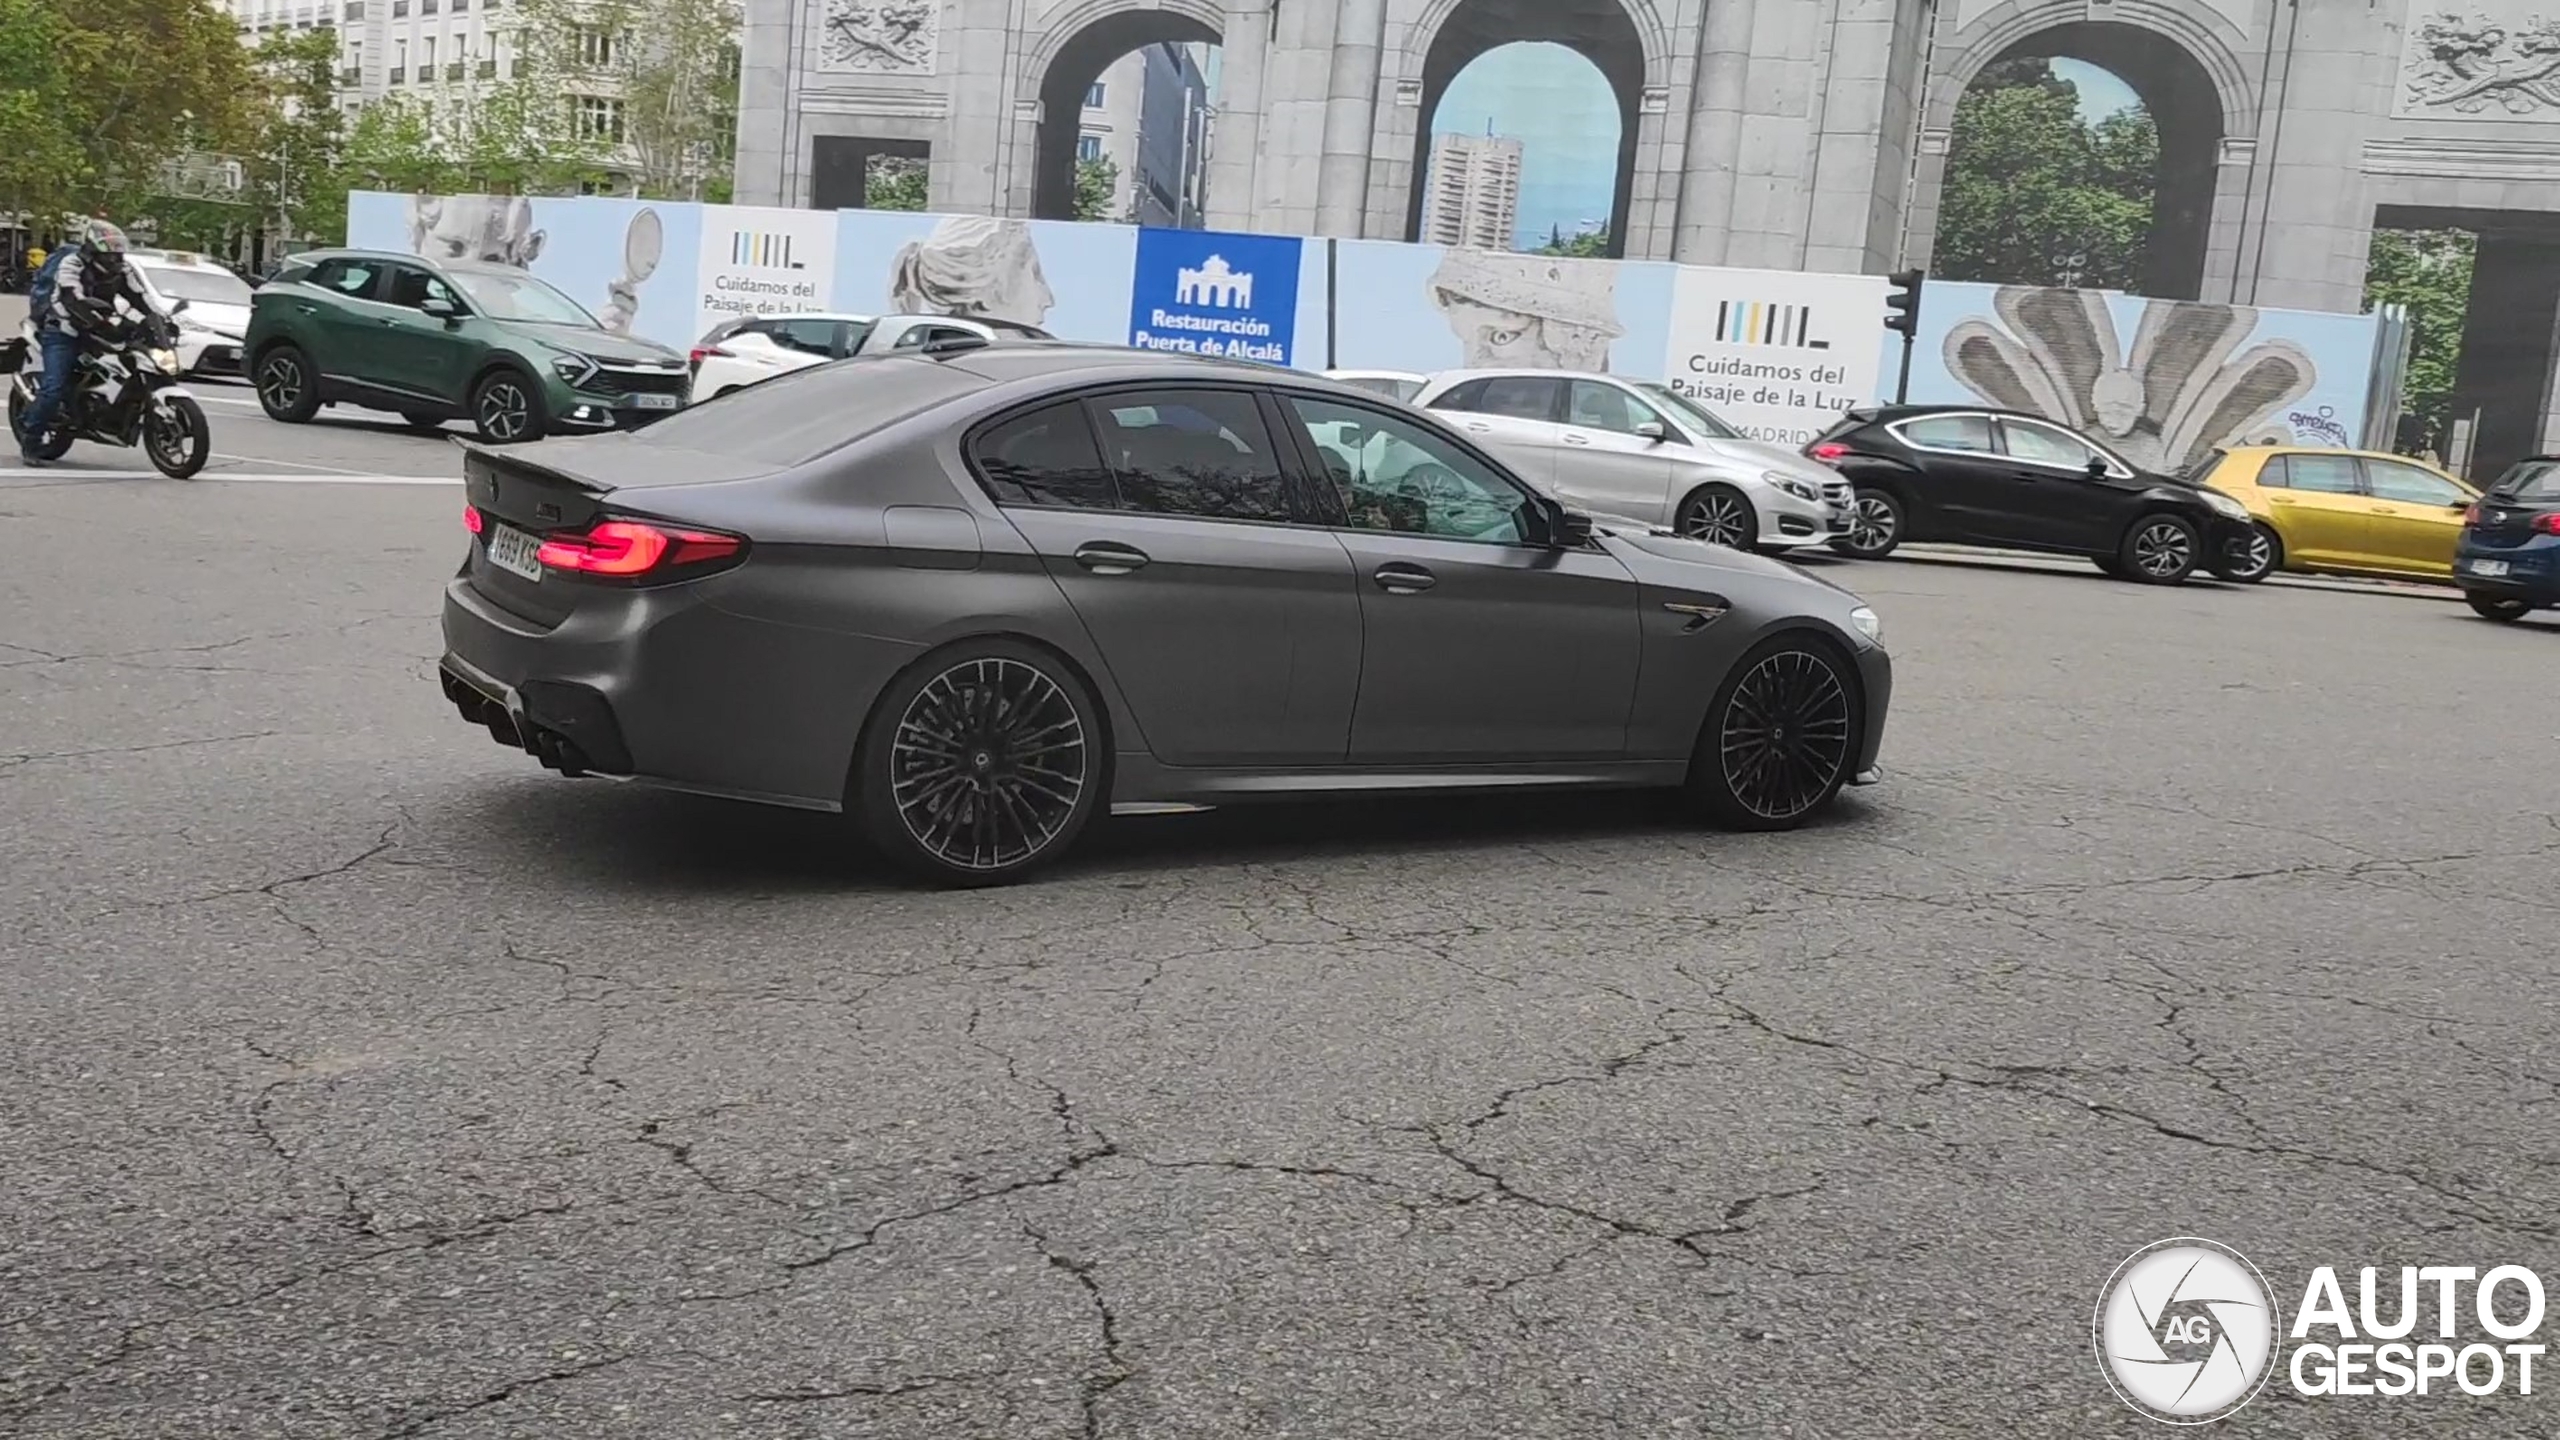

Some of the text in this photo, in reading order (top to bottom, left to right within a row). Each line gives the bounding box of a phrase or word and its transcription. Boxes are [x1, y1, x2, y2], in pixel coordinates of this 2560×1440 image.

[715, 275, 815, 297] Cuidamos del
[704, 294, 753, 316] Paisaje
[757, 300, 775, 314] de
[1151, 309, 1270, 337] Restauración
[1135, 330, 1283, 361] Puerta de Alcalá
[1688, 354, 1845, 385] Cuidamos del
[1672, 378, 1857, 411] Paisaje de la Luz
